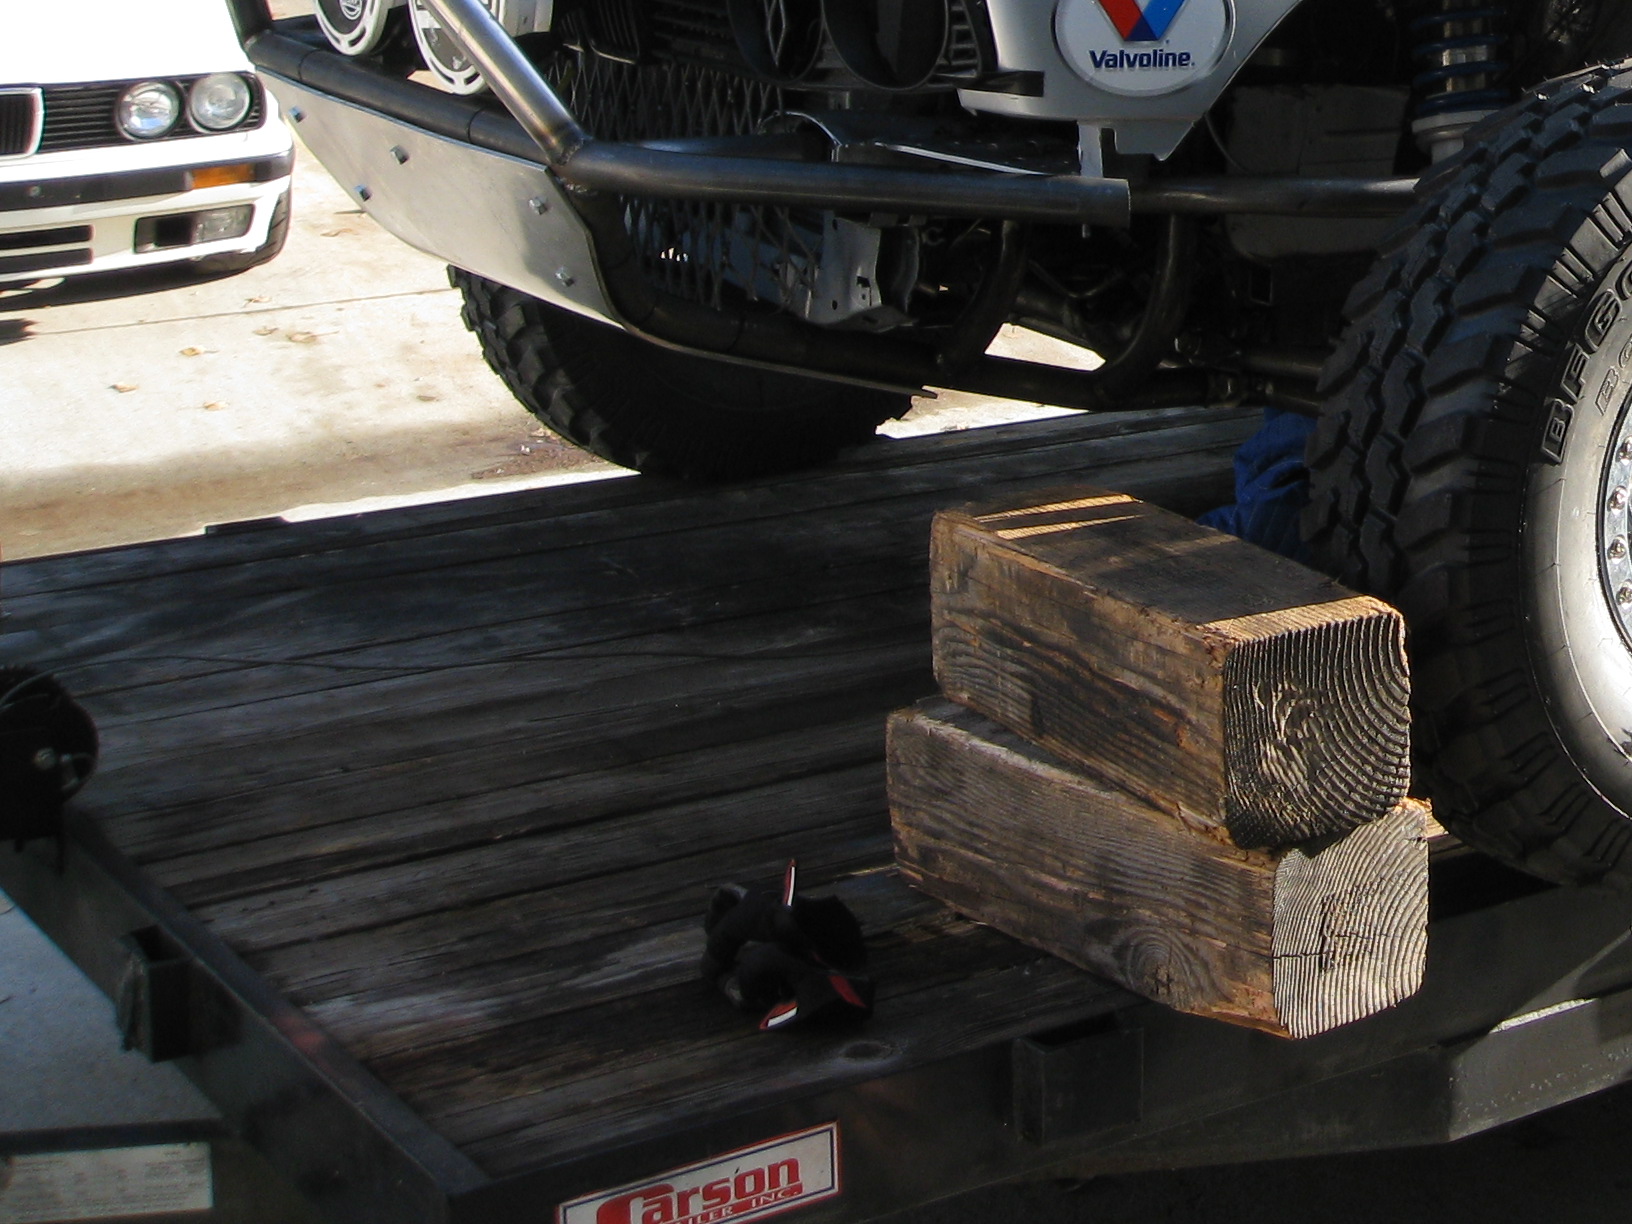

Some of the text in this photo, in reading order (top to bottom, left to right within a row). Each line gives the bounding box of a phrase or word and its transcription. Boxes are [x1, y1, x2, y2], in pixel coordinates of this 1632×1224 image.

[1089, 48, 1192, 69] Valvoline
[596, 1157, 801, 1224] Carson
[751, 1188, 799, 1208] INC.
